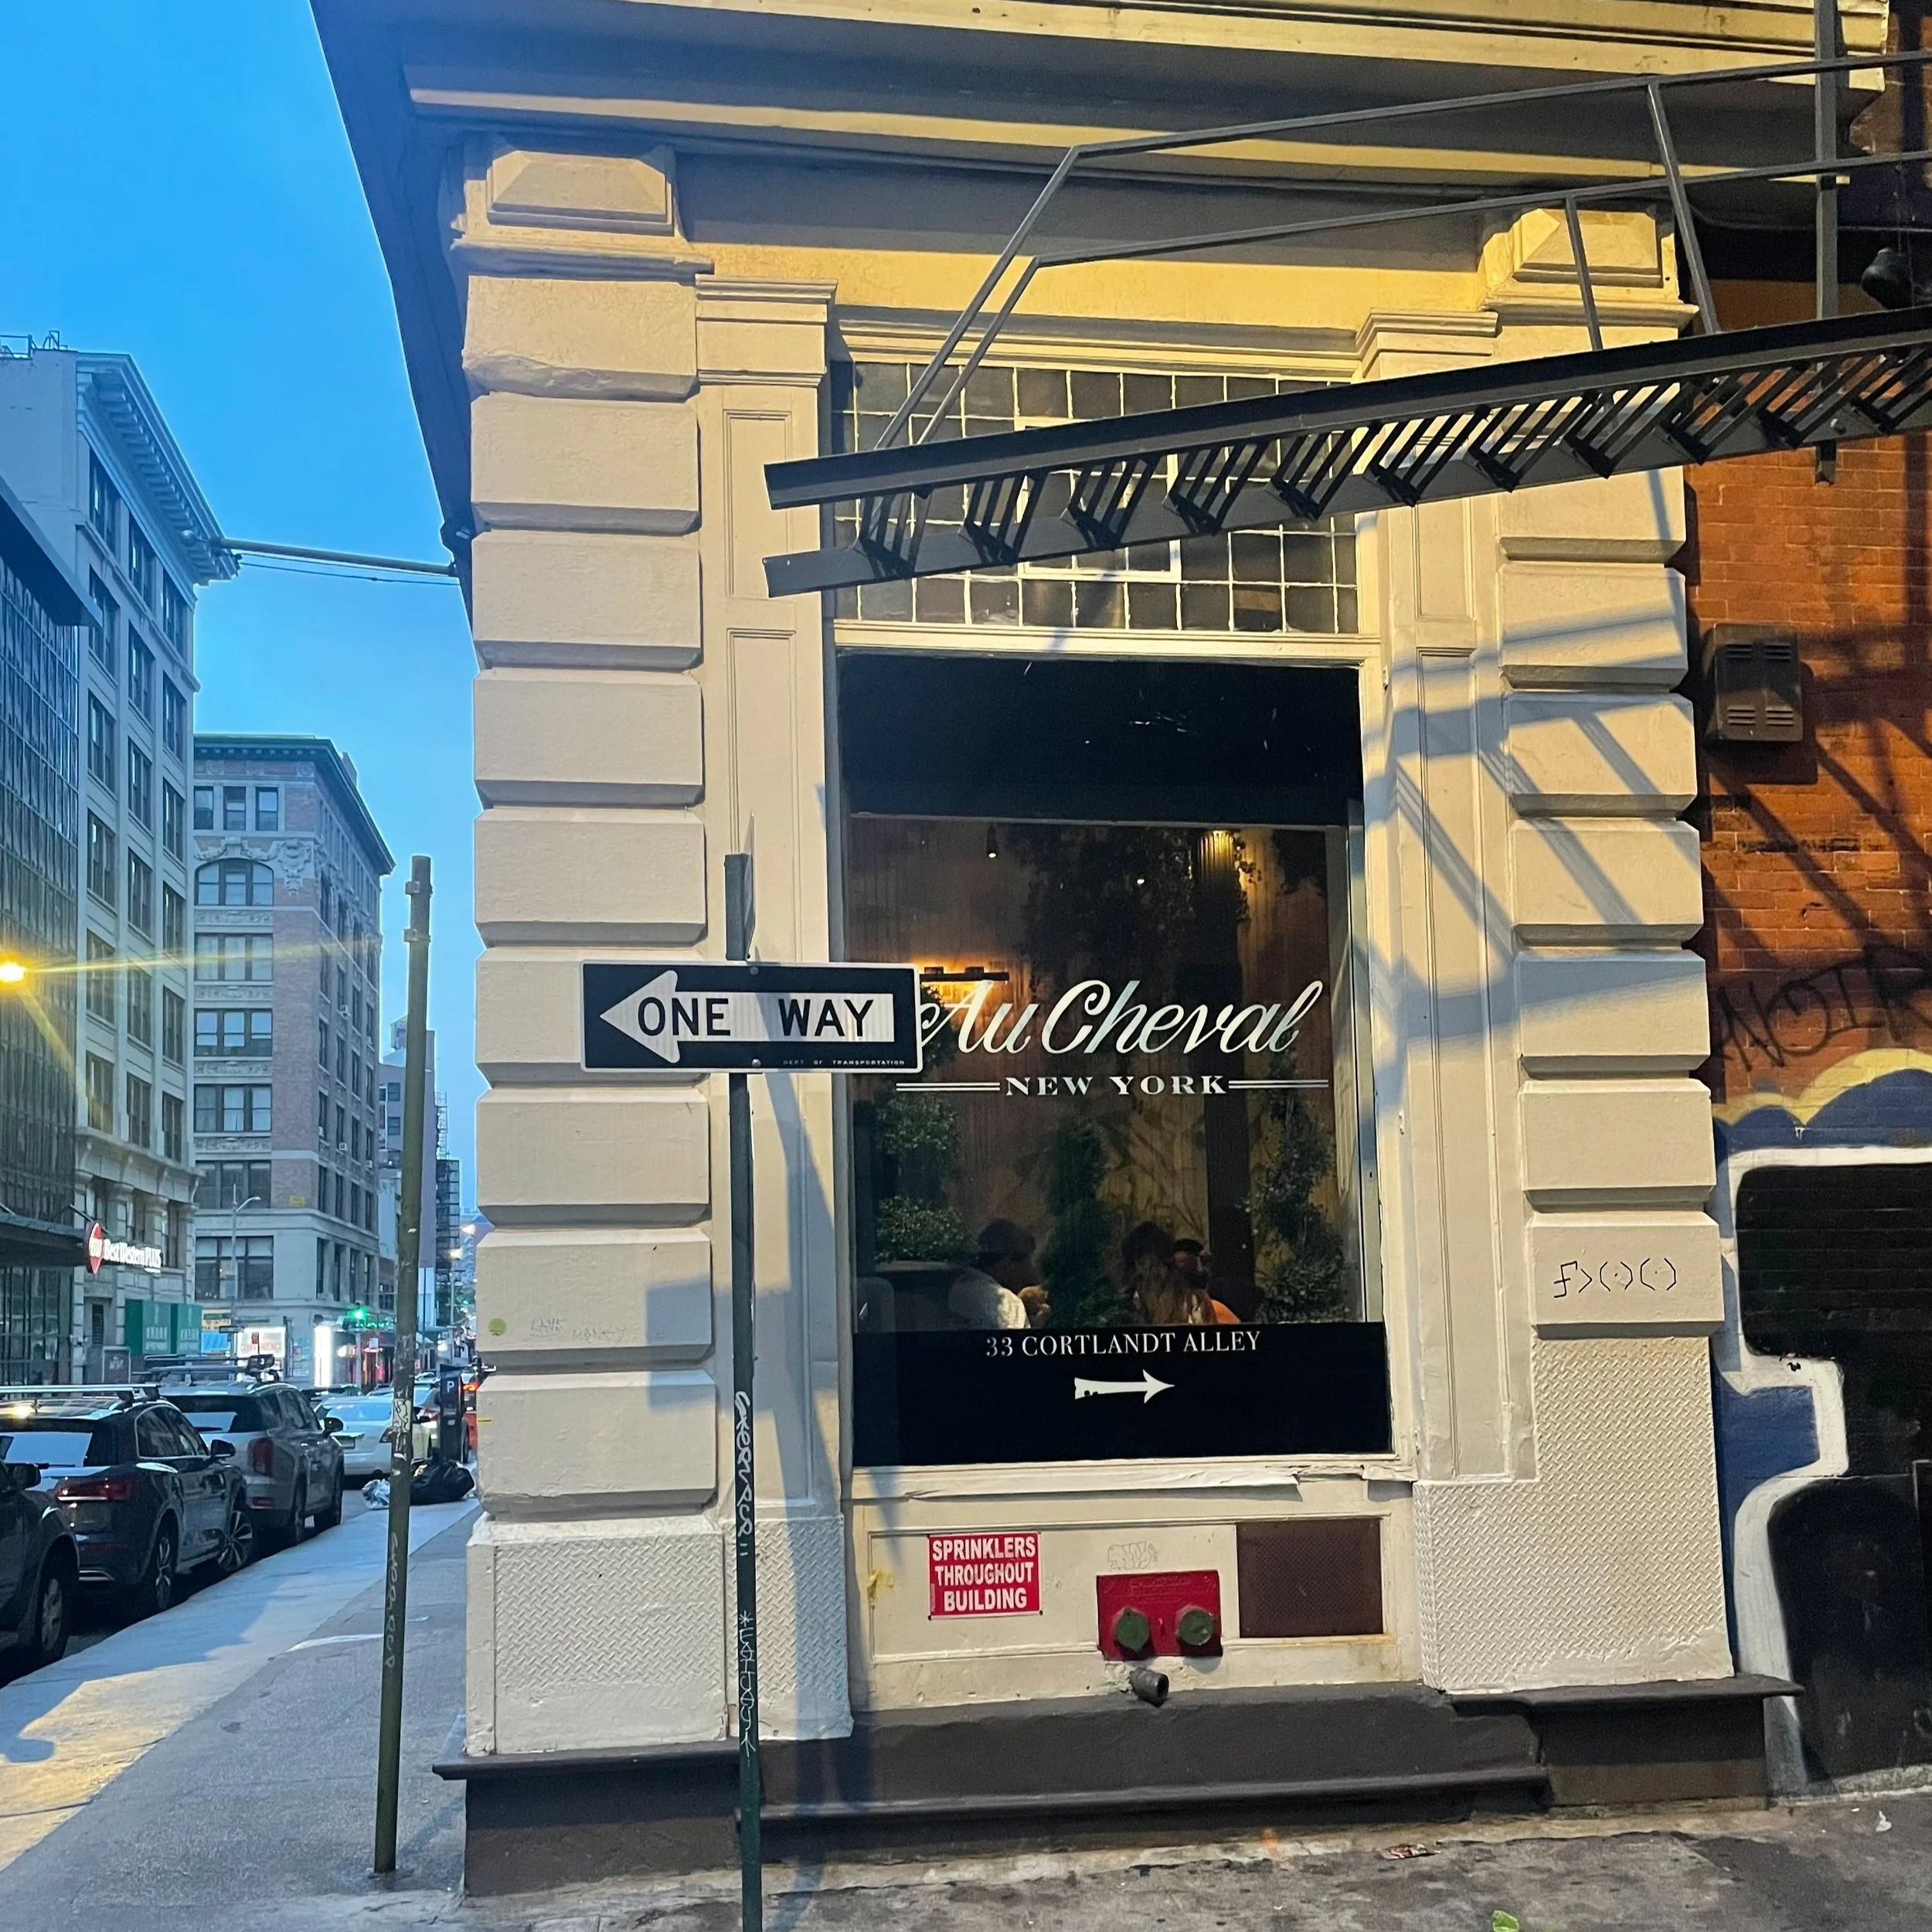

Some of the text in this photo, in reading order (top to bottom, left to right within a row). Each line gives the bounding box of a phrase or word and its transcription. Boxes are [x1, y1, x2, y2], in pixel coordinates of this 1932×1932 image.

[638, 996, 874, 1037] ONE WAY
[922, 979, 1323, 1054] Au Cheval
[1005, 1075, 1228, 1097] NEW YORK
[986, 1330, 1261, 1357] 33 CORTLANDT ALLEY
[932, 1536, 1036, 1562] SPRINKLERS
[934, 1561, 1034, 1587] THROUGHOUT
[944, 1587, 1028, 1612] BUILDING
